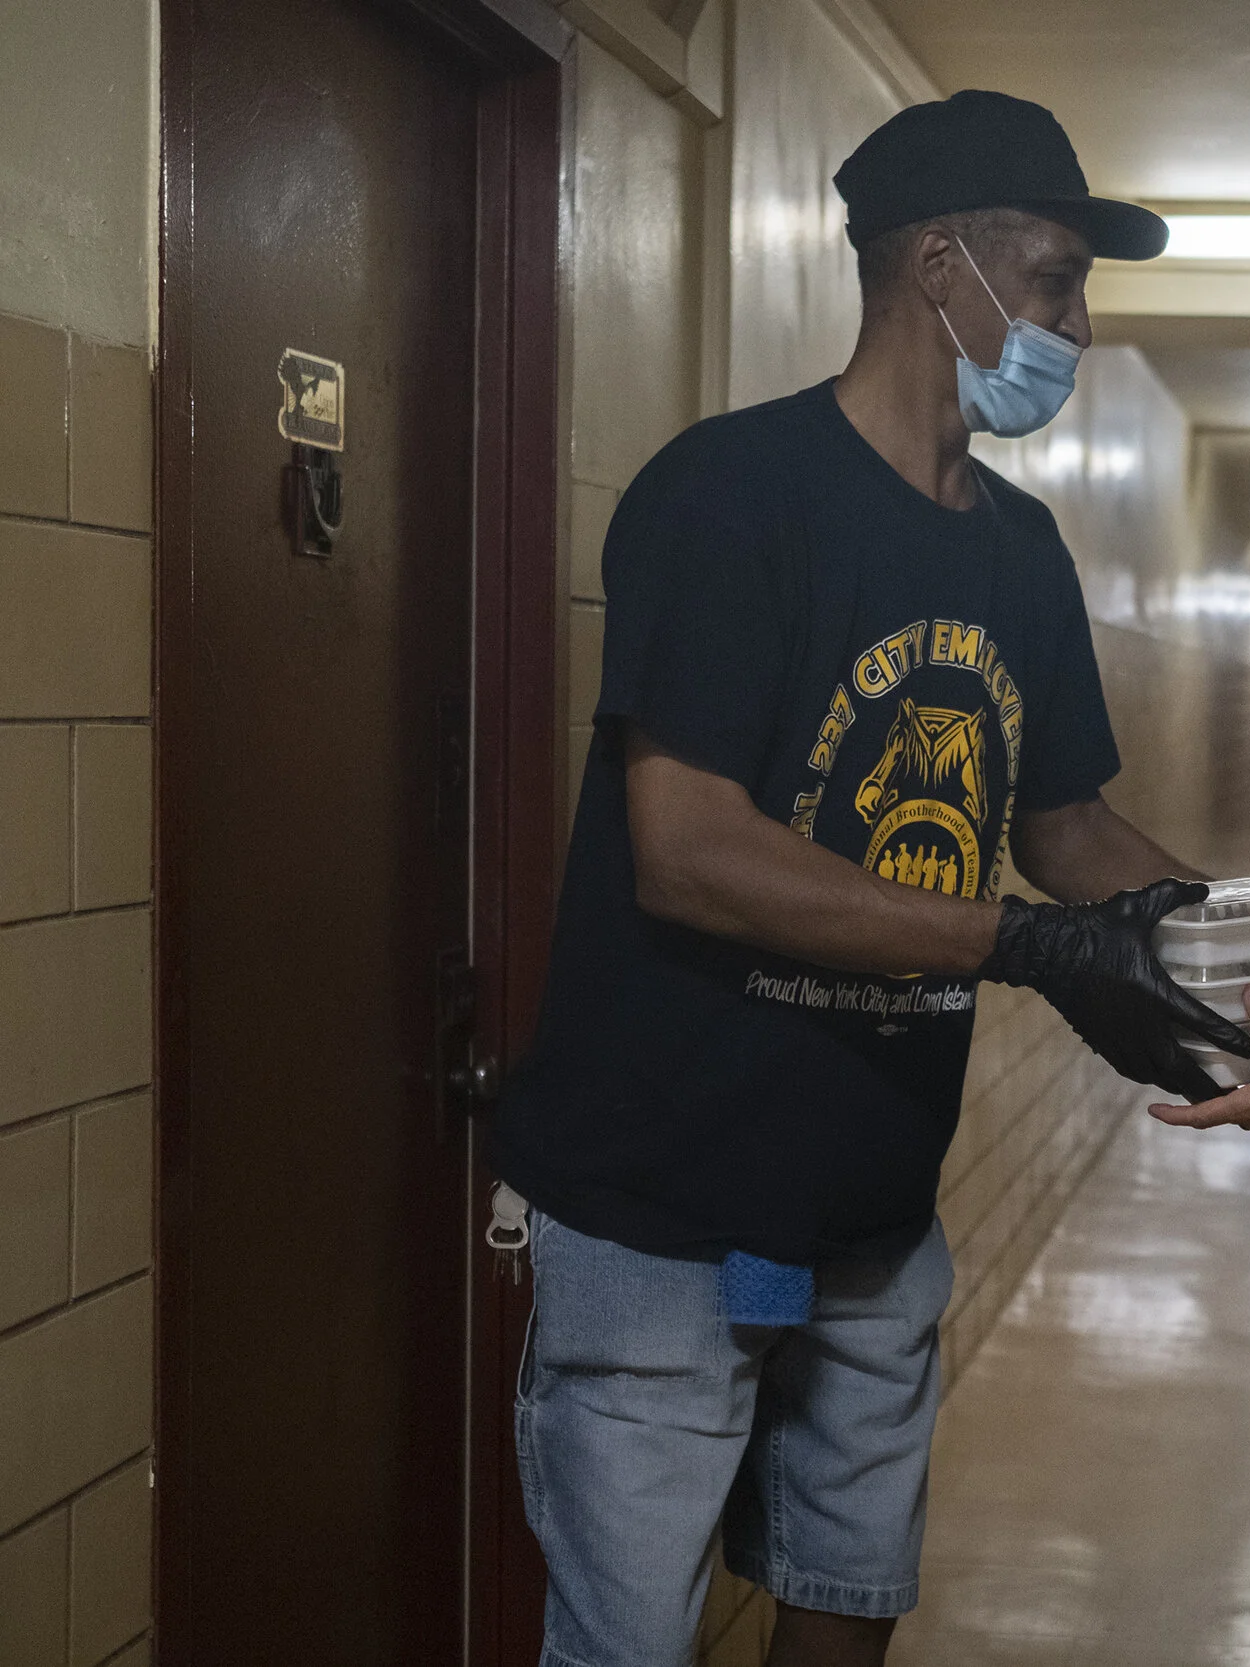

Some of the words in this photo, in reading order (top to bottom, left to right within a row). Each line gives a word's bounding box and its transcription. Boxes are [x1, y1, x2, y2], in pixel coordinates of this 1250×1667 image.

[808, 683, 855, 777] 237
[853, 619, 927, 698] CITY
[896, 803, 965, 833] Brotherhood
[961, 833, 974, 847] of
[865, 818, 894, 867] ational
[964, 847, 977, 897] Teams
[745, 970, 799, 1001] Proud
[800, 978, 835, 1007] New
[834, 982, 860, 1009] York
[862, 985, 889, 1018] City
[890, 986, 914, 1015] and
[913, 986, 941, 1016] Long
